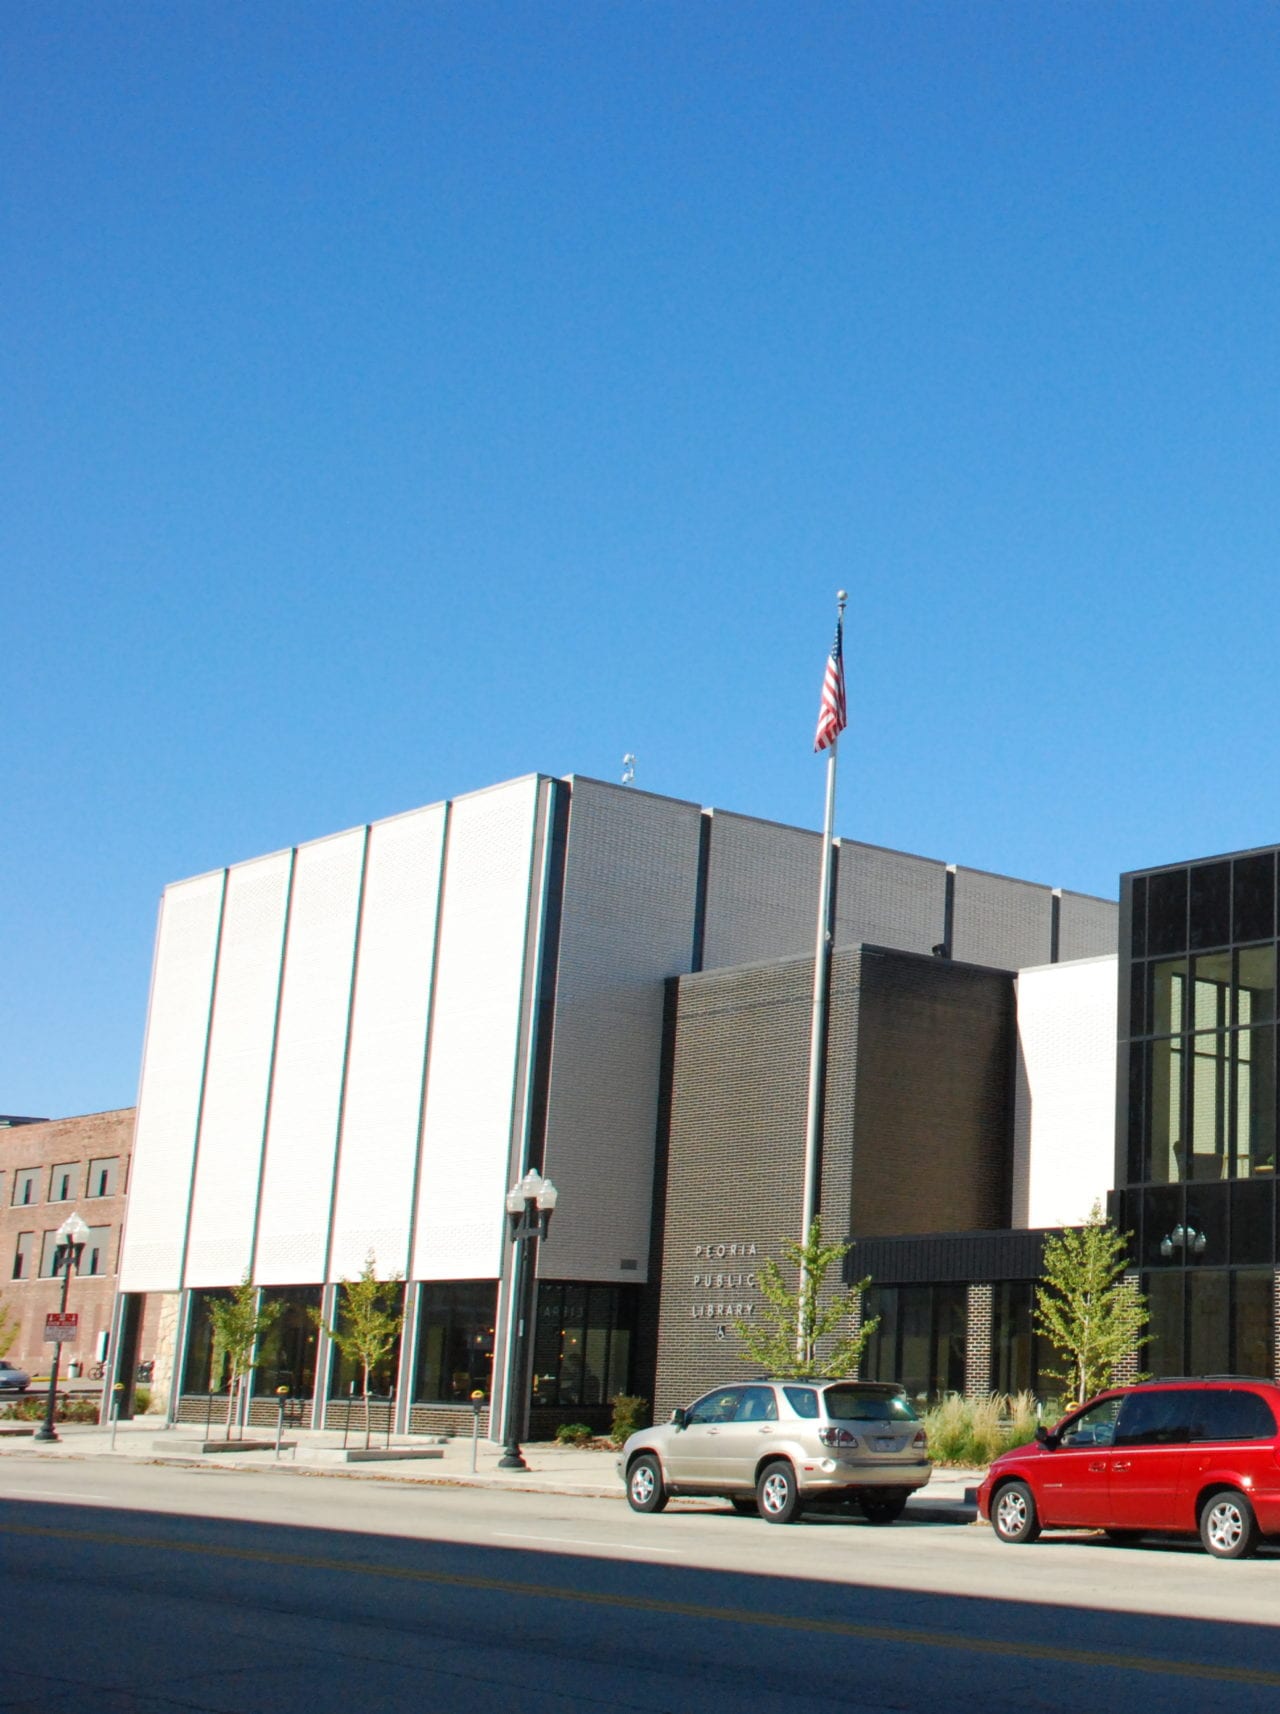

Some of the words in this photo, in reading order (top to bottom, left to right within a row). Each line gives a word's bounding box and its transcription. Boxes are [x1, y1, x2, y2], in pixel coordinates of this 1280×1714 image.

[695, 1244, 757, 1257] PEORIA
[693, 1273, 755, 1287] PUBLIC
[692, 1303, 755, 1318] LIBRARY
